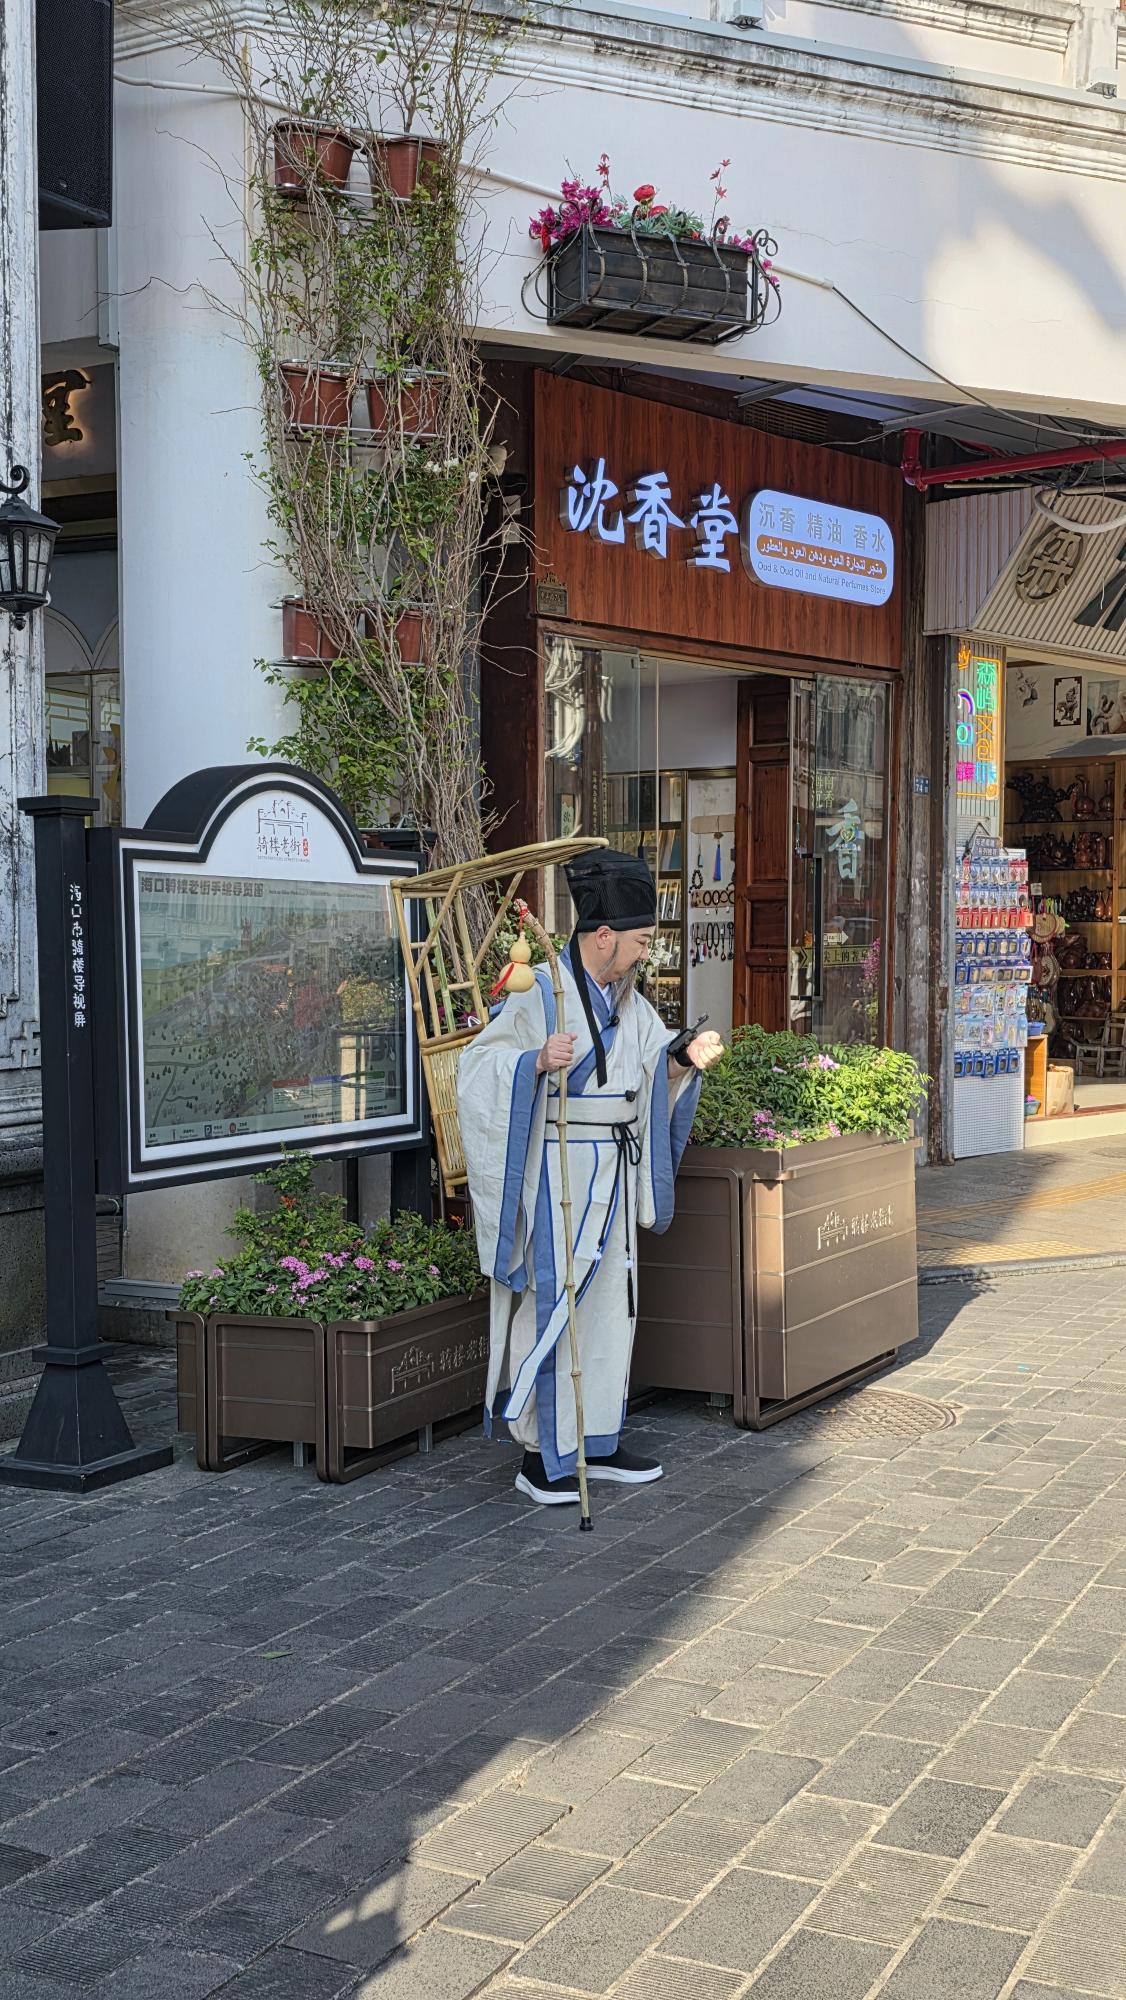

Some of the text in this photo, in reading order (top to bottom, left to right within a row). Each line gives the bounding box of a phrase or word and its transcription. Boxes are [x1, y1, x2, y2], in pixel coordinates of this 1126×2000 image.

[759, 502, 886, 553] 沉香 精油 香水
[757, 561, 772, 573] Oud
[780, 565, 794, 577] Oud
[795, 568, 804, 579] Oil
[805, 571, 817, 581] and
[818, 574, 839, 586] Natural
[841, 578, 869, 593] Perfumes
[870, 584, 886, 596] Store
